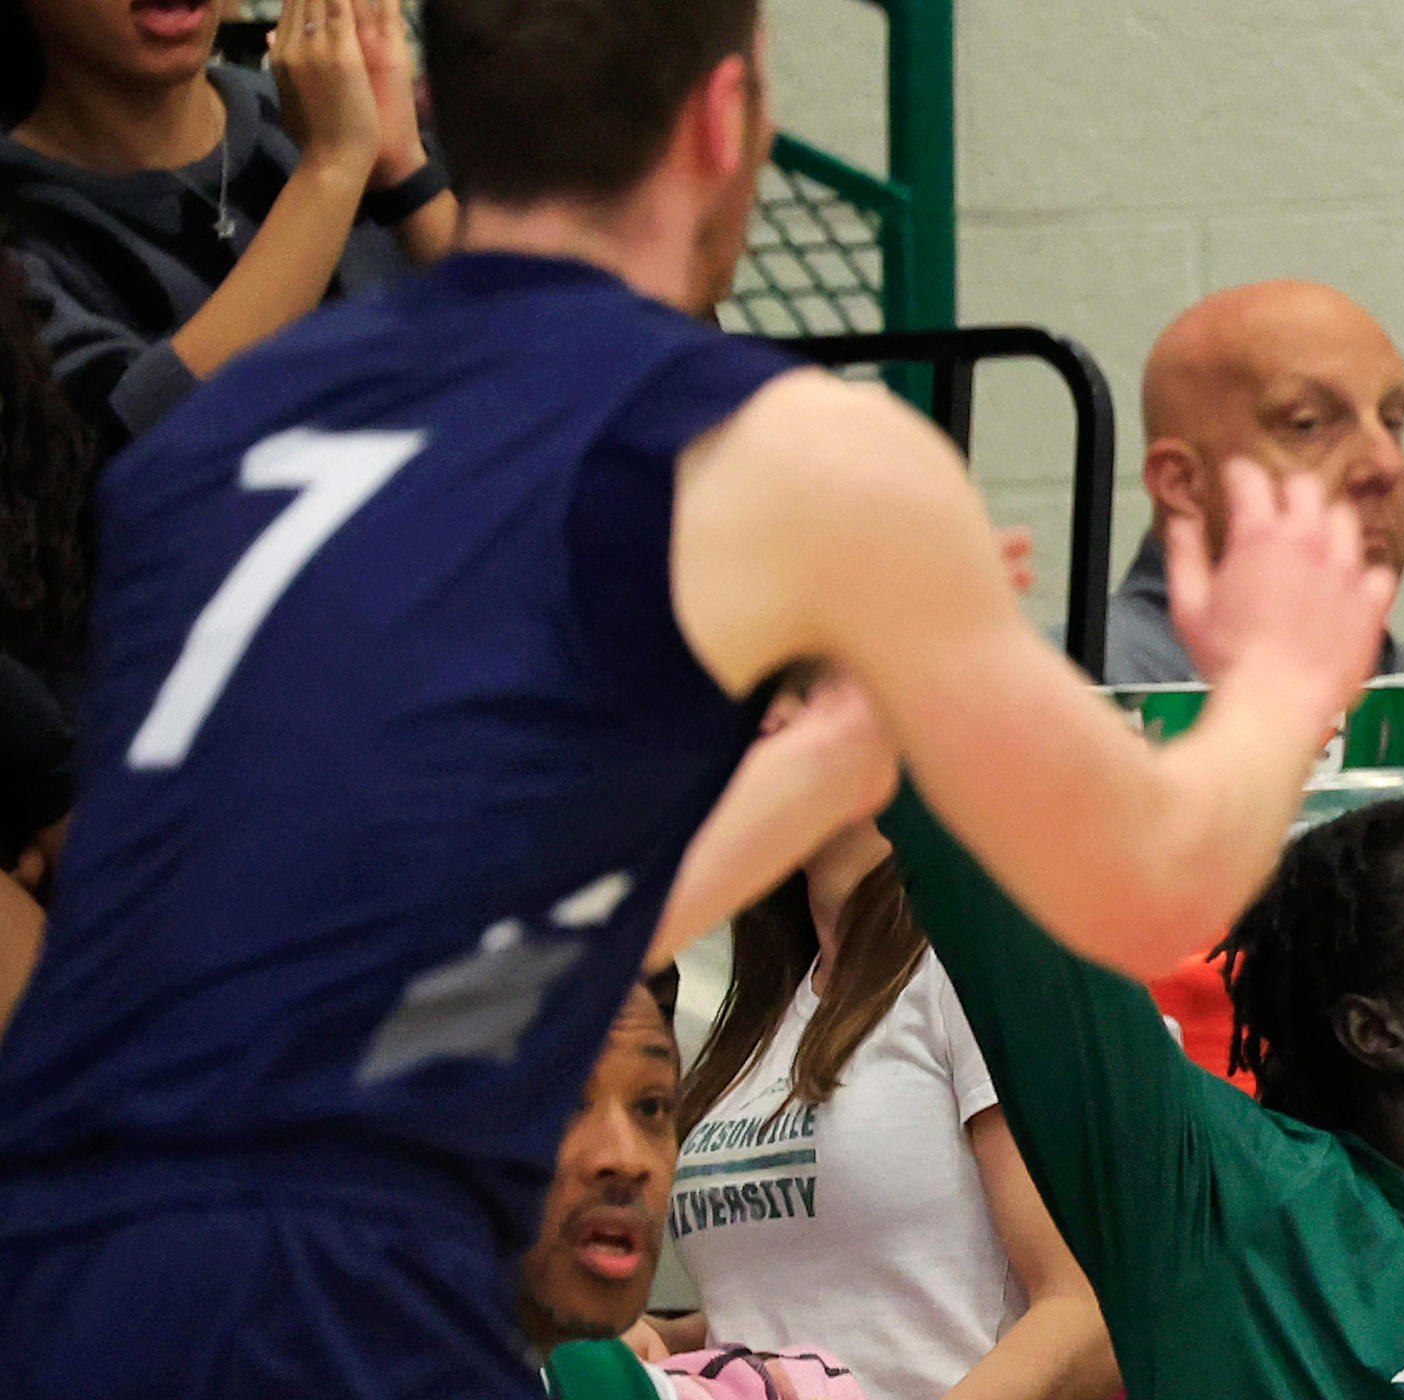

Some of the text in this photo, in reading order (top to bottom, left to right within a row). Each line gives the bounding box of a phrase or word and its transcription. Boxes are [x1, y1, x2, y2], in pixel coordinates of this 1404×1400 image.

[126, 426, 427, 770] 7
[682, 1104, 816, 1156] CKSONILLE
[670, 1176, 817, 1239] IVERSITY
